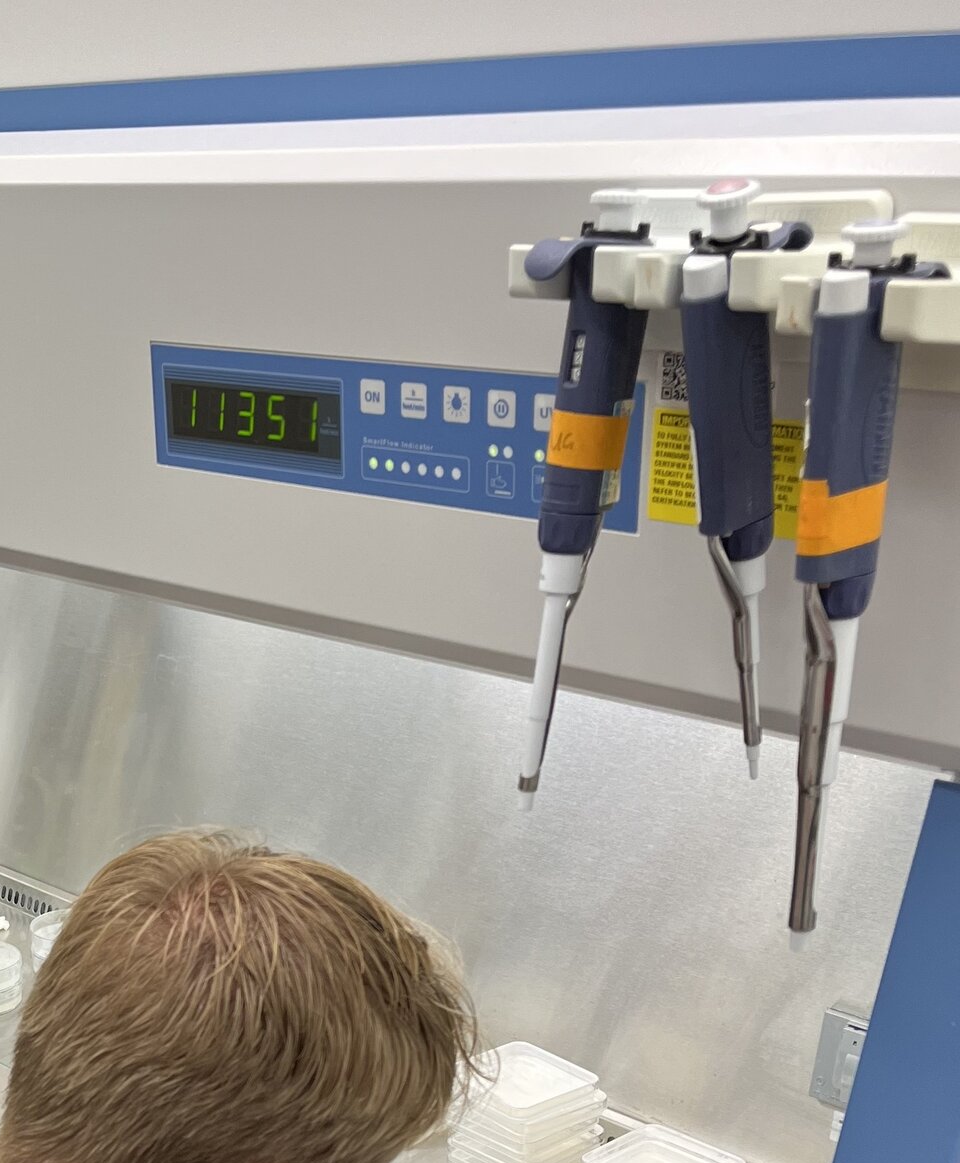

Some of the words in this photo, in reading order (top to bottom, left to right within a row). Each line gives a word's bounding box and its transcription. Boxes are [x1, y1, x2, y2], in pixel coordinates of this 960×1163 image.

[364, 390, 381, 403] ON
[191, 388, 318, 442] 11351
[362, 436, 399, 448] SmartFlow
[401, 441, 434, 452] Indicator
